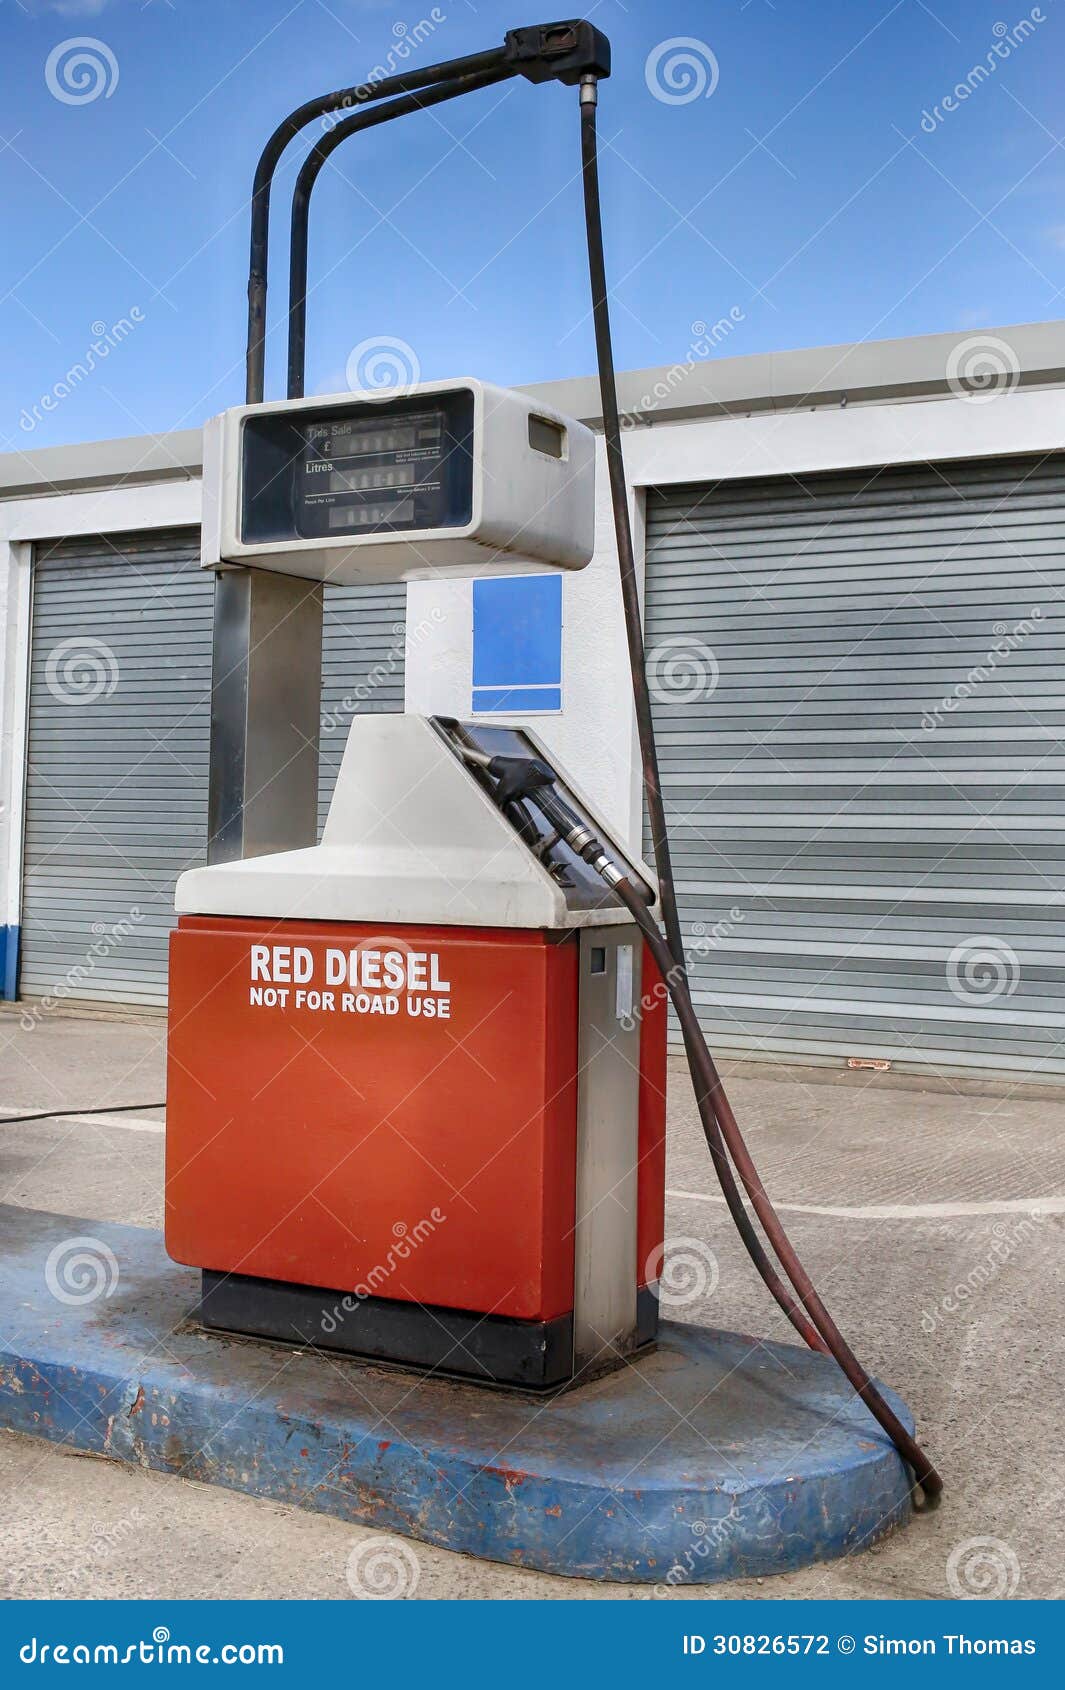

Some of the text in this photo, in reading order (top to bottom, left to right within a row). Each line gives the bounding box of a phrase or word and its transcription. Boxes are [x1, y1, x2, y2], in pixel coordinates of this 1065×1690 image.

[331, 423, 353, 436] Sale
[324, 441, 331, 452] £
[305, 462, 333, 474] Litres
[250, 944, 451, 992] RED DIESEL
[249, 987, 451, 1019] NOT FOR ROAD USE
